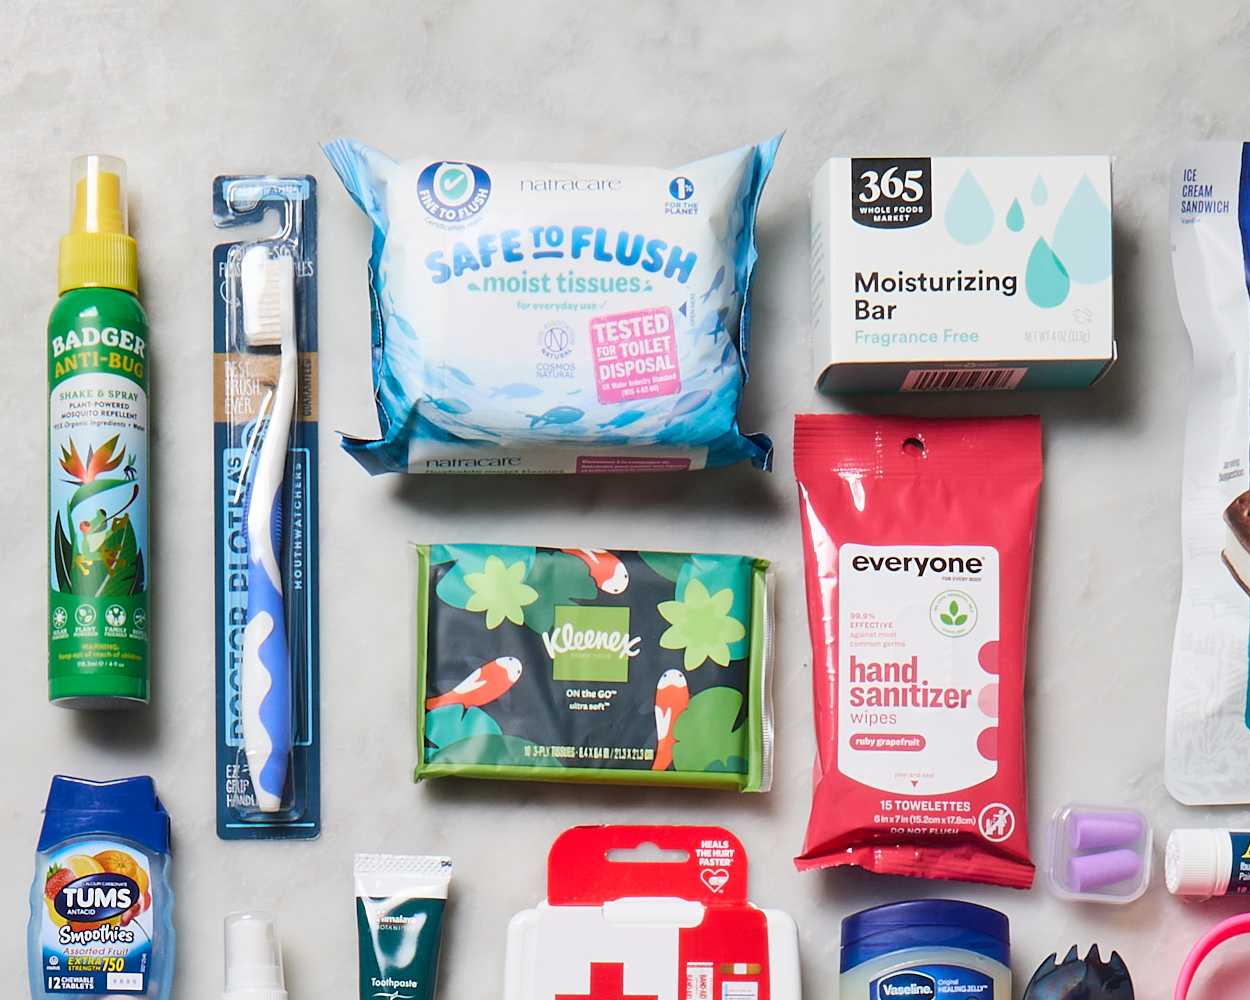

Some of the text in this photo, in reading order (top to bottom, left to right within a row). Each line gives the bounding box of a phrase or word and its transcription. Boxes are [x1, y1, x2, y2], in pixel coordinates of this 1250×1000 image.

[858, 166, 924, 203] 365
[1183, 168, 1197, 183] ICE
[1181, 184, 1213, 199] CREAM
[664, 208, 699, 216] PLANET
[859, 205, 924, 214] WHOLE FOODS
[1180, 199, 1230, 215] SANDWICH
[873, 214, 911, 223] MARKET
[424, 225, 698, 285] SAFE TO FLUSH
[483, 268, 641, 293] moist tissues
[854, 269, 1018, 297] Moisturizing
[854, 299, 897, 321] Bar
[593, 312, 669, 343] TESTED
[854, 328, 980, 345] Fragrance Free
[52, 327, 145, 359] BADGER
[596, 335, 671, 358] FOR TOILET
[55, 351, 144, 379] ANTI-BUG
[599, 354, 676, 381] DISPOSAL
[61, 409, 138, 420] MOSQUITO REPELLENT
[851, 553, 983, 578] everyone
[542, 622, 642, 659] Kleenex
[849, 655, 918, 684] hand
[849, 680, 972, 709] sanitizer
[849, 710, 897, 727] wipes
[855, 735, 921, 748] ruby grapefruit
[225, 780, 250, 794] GRIP
[880, 799, 972, 813] 15 TOWELETTES
[701, 840, 730, 849] HEALS
[63, 887, 132, 909] TUMS
[66, 908, 96, 916] ANTACID
[59, 923, 135, 946] Smoothies
[102, 957, 125, 972] 750
[370, 976, 418, 990] Toothpaste
